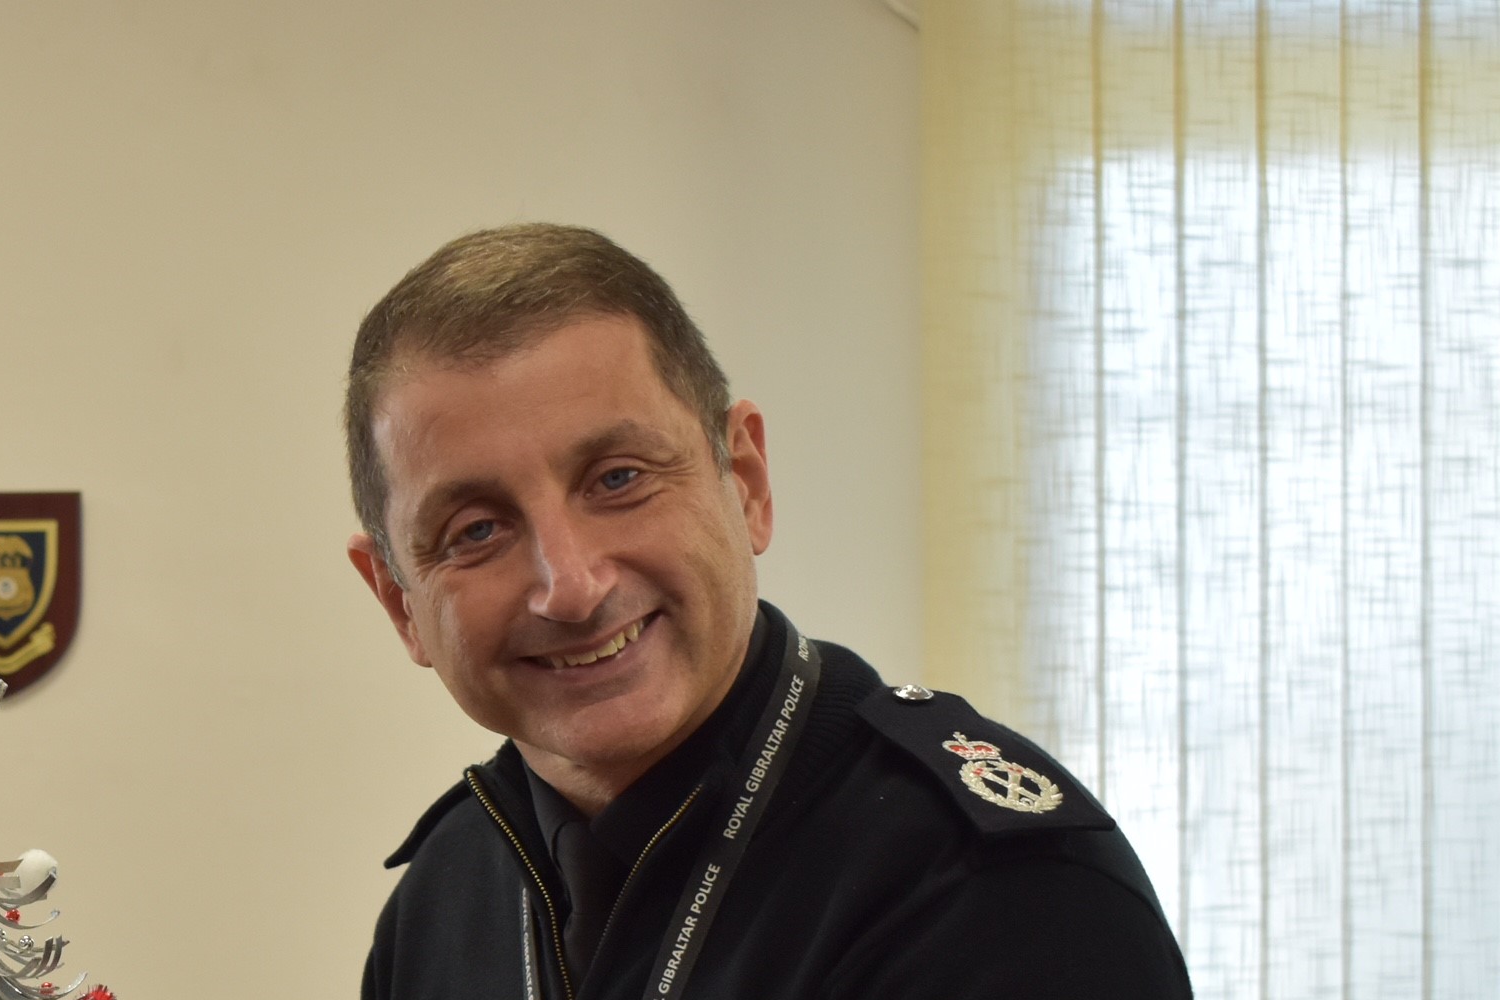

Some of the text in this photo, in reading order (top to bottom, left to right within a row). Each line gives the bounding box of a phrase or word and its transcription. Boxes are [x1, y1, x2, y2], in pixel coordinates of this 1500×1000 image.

[723, 674, 804, 839] ROYAL GIBRALTAR POLICE
[658, 916, 698, 994] GIBRALTAR
[690, 863, 721, 914] POLICE
